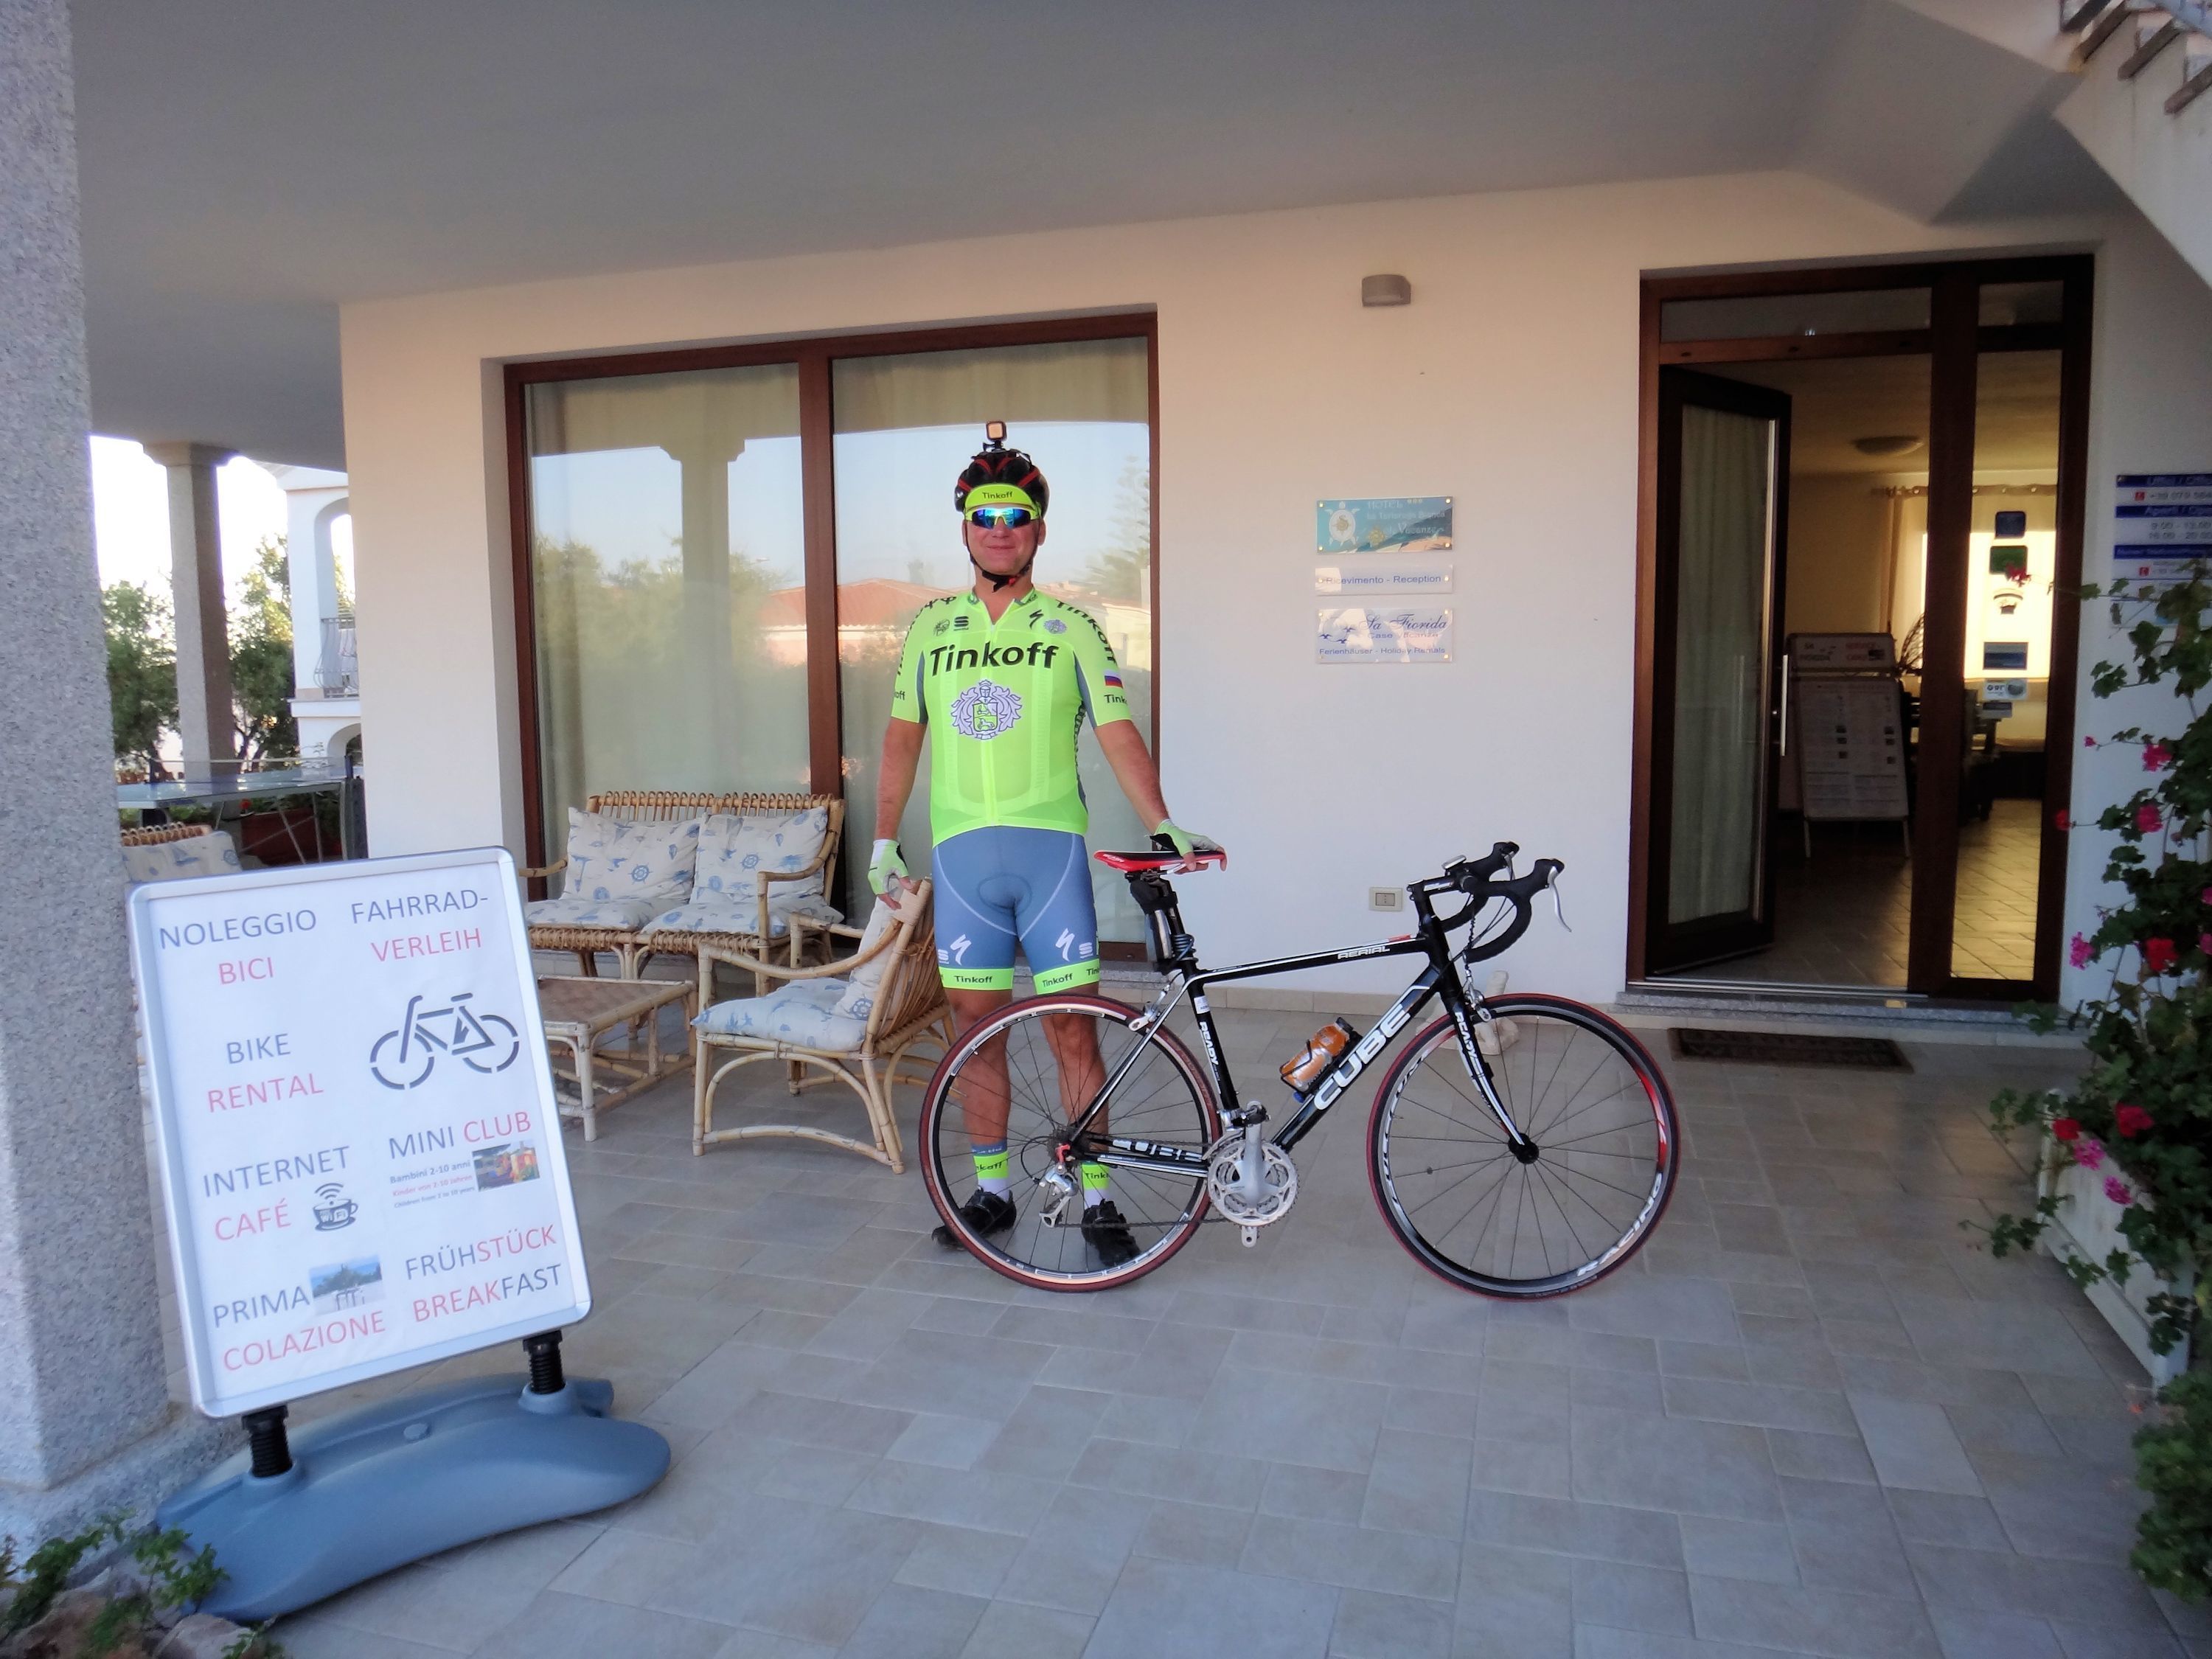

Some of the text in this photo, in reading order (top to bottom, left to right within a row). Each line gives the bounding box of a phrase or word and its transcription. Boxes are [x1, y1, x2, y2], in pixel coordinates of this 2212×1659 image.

[981, 491, 1013, 501] Tinkoff
[1367, 500, 1404, 509] HOTEL
[1326, 577, 1384, 585] Ricevimento
[1393, 576, 1441, 585] Reception
[1389, 613, 1448, 630] Fiorida
[930, 641, 1060, 678] Tinkoff
[1319, 647, 1373, 655] Ferienhäuser
[350, 888, 488, 925] FAHRRAD-
[159, 908, 317, 950] NOLEGGIO
[371, 927, 481, 962] VERLEIH
[218, 957, 274, 985] BICI
[1337, 945, 1391, 960] AERIAL
[954, 975, 992, 984] Tinkoff
[1042, 973, 1074, 989] Tinkoff
[226, 1033, 291, 1065] BIKE
[1199, 1021, 1219, 1066] READY
[1314, 1003, 1411, 1110] CUBE
[207, 1072, 324, 1113] RENTAL
[389, 1110, 532, 1160] MINI CLUB
[203, 1145, 350, 1198] INTERNET
[390, 1160, 471, 1184] Bambini 2-10 anni
[215, 1198, 292, 1241] CAFÉ
[1576, 1172, 1663, 1277] RACING
[405, 1224, 557, 1280] FRÜHSTÜCK
[212, 1284, 310, 1328] PRIMA
[413, 1263, 562, 1323] BREAKFAST
[223, 1310, 386, 1371] COLAZIONE
